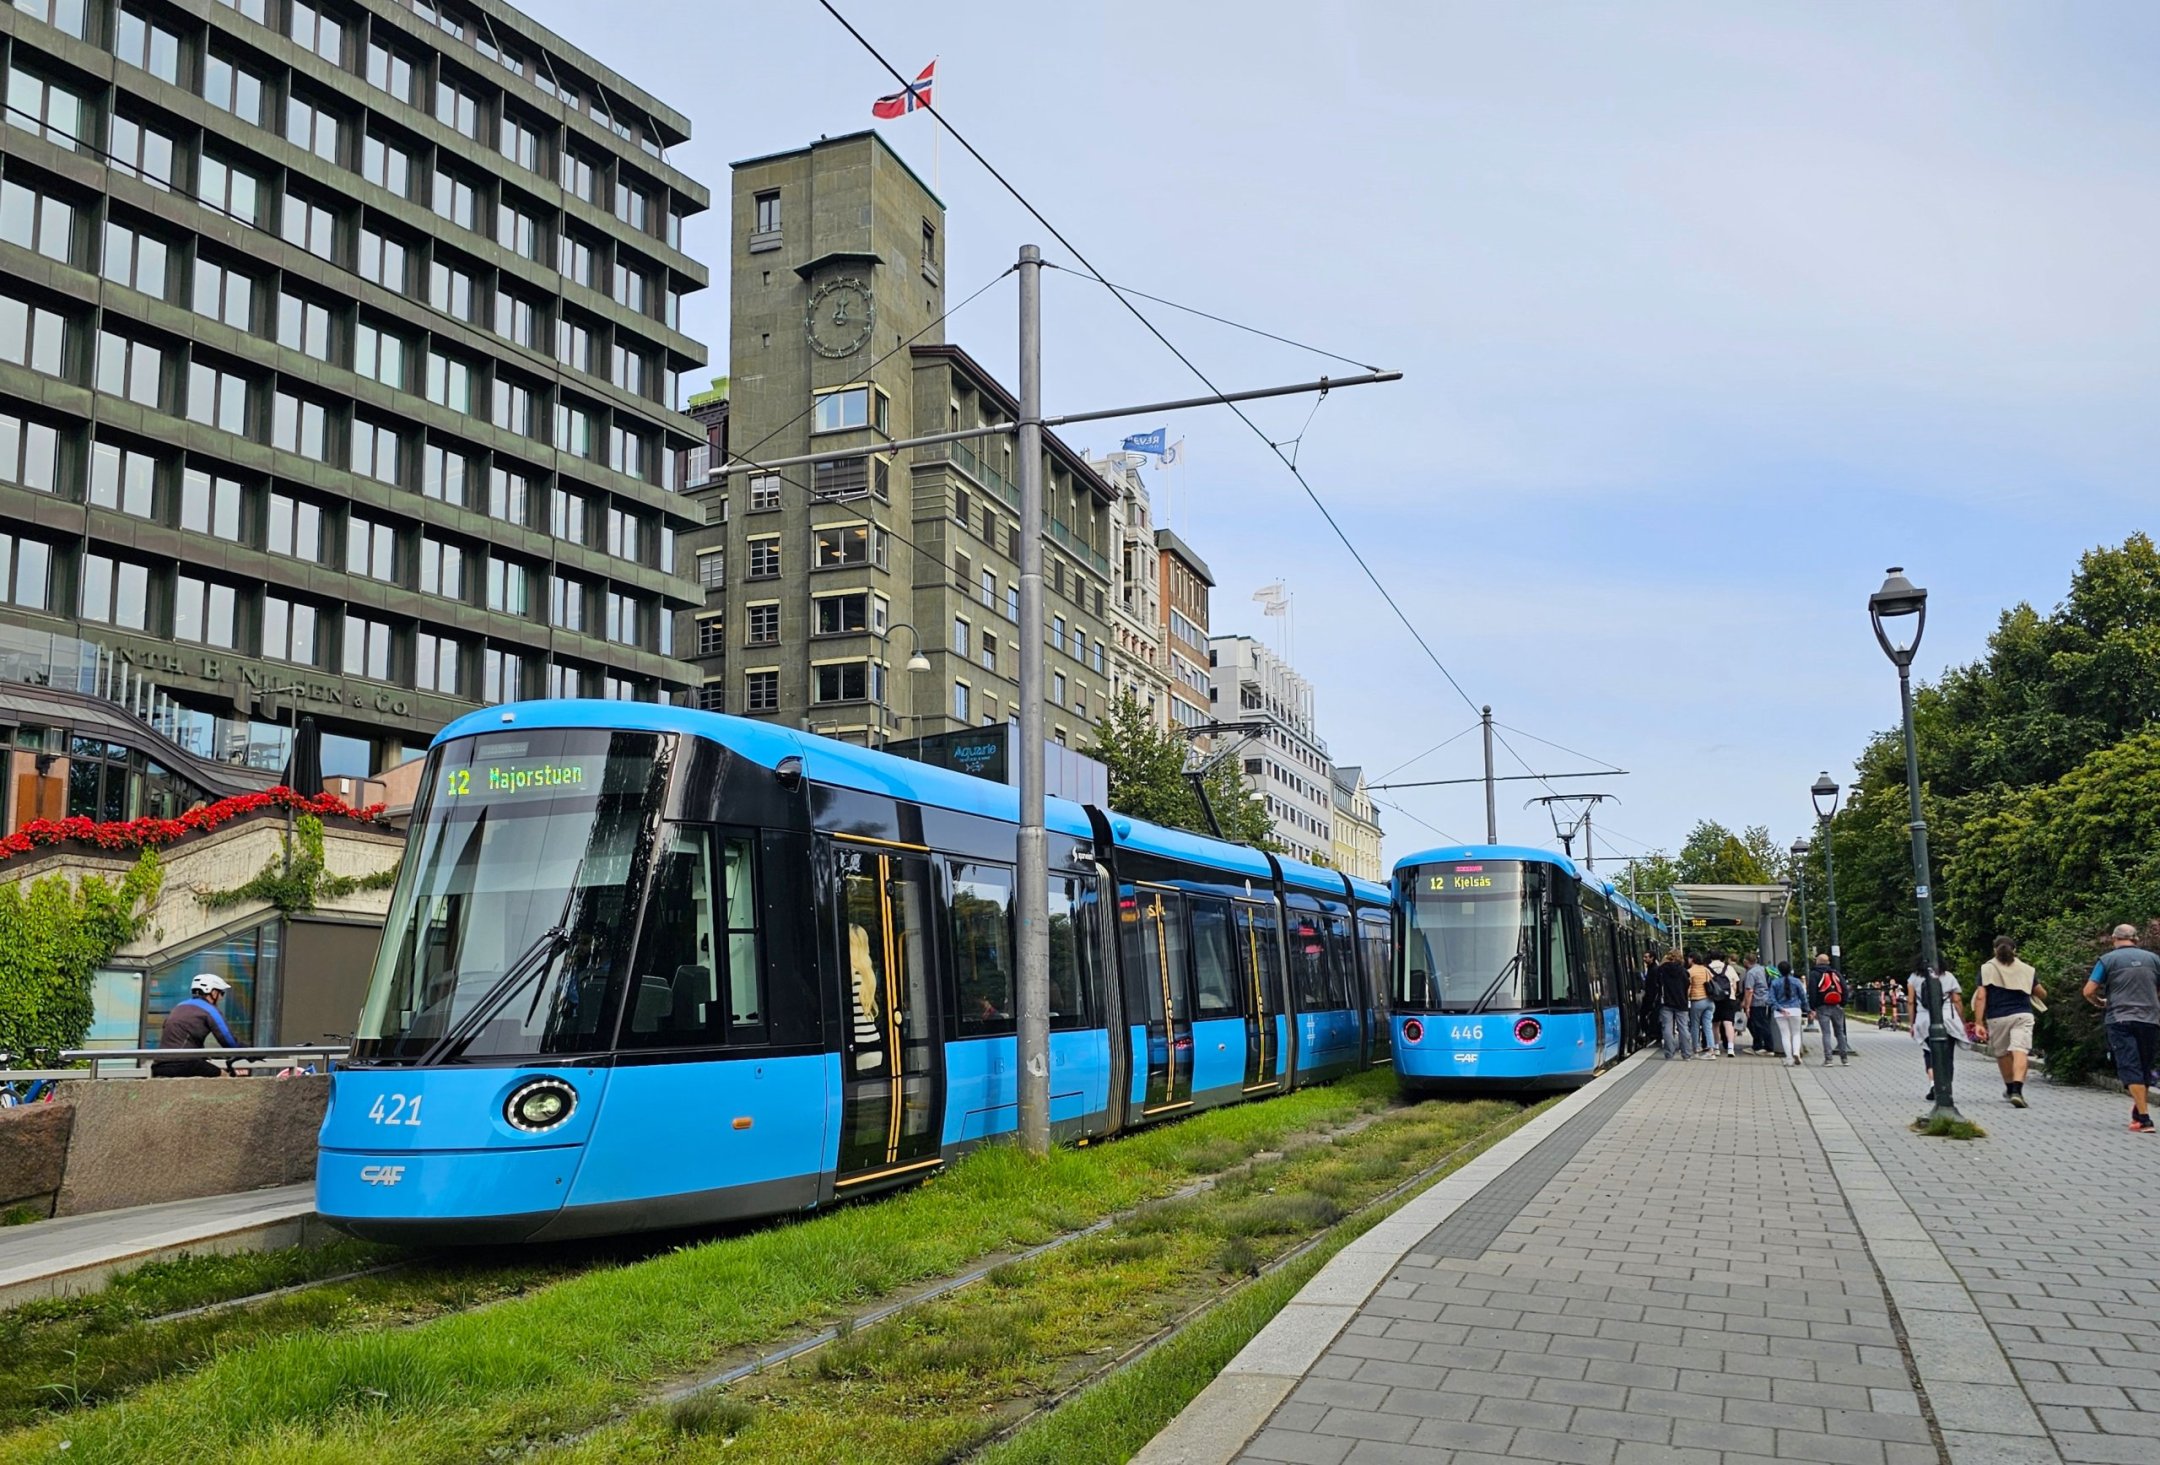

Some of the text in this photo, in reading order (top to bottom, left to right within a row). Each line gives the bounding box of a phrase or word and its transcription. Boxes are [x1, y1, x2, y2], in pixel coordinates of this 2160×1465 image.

[354, 696, 362, 708] &
[448, 764, 582, 796] 12 Majorstuen
[1430, 875, 1491, 890] 12 Kjelsås
[1451, 1025, 1483, 1040] 446
[1454, 1053, 1478, 1063] CAF
[368, 1093, 423, 1126] 421
[360, 1165, 405, 1186] CAF
